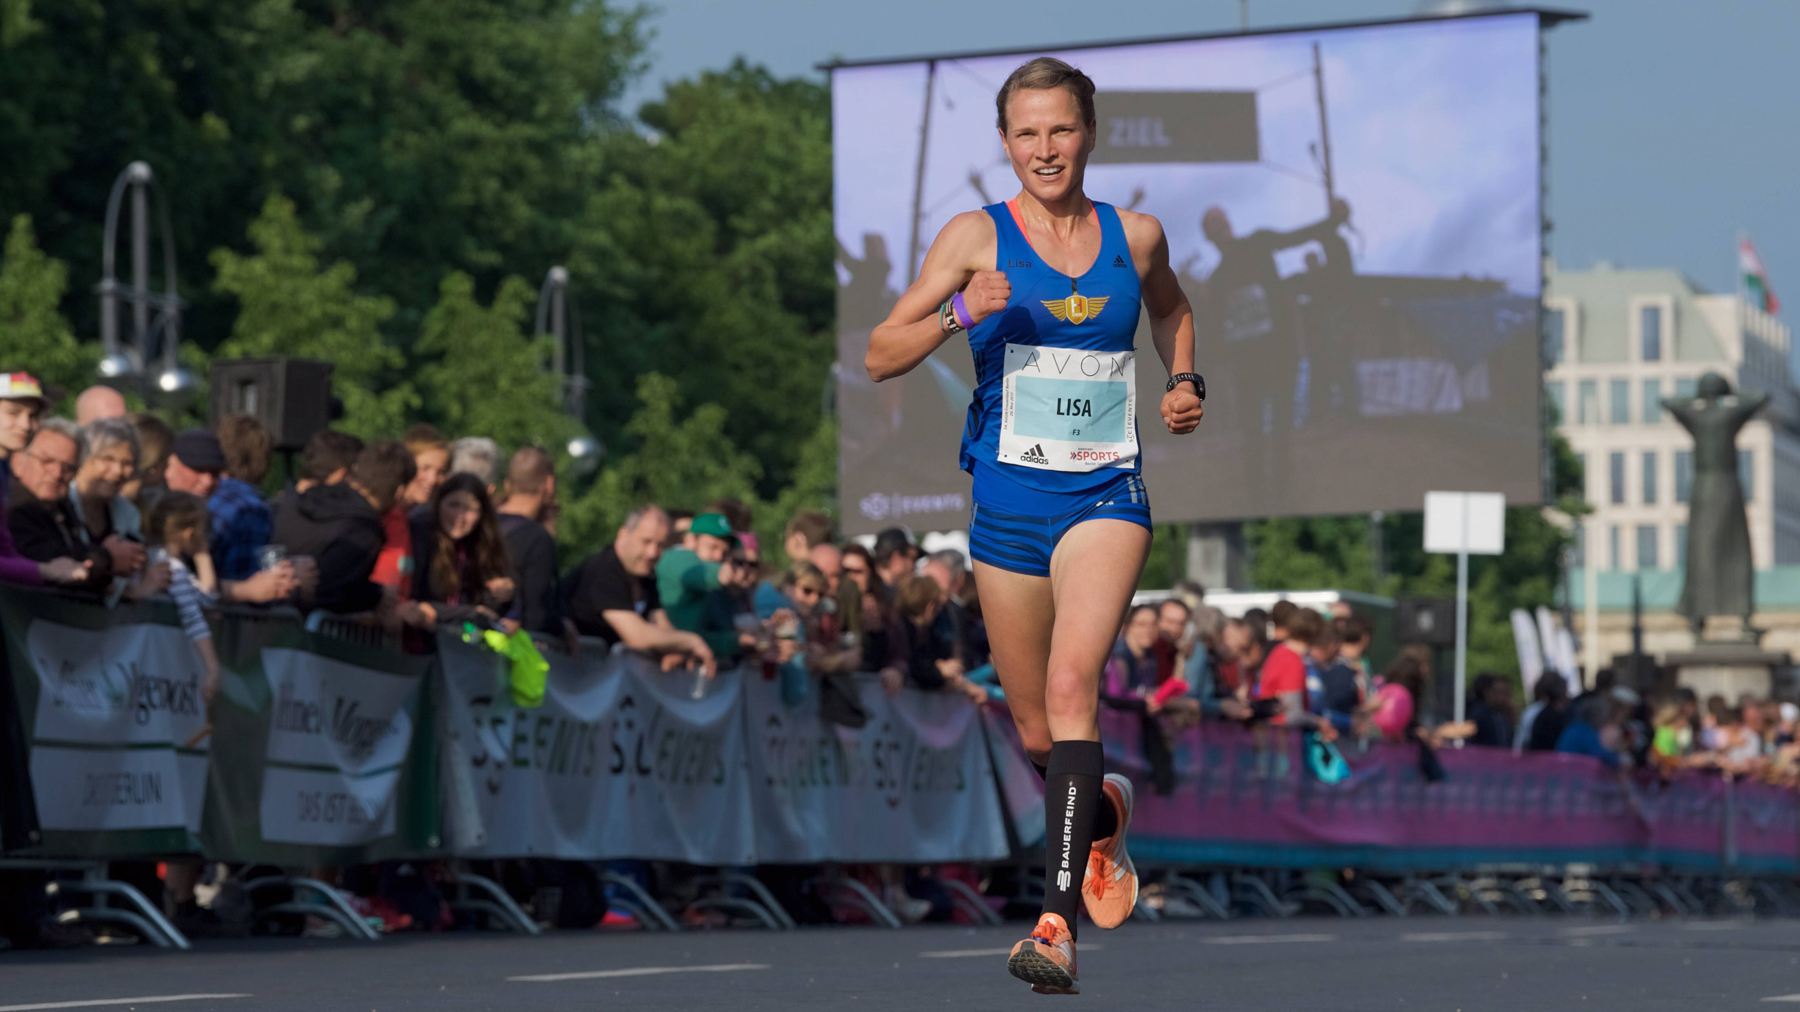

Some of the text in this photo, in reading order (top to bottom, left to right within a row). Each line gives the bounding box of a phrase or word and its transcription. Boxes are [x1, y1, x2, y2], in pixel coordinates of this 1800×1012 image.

[1108, 117, 1171, 146] ZIEL
[1008, 259, 1032, 268] Lisa
[1022, 352, 1125, 377] AVON
[1057, 398, 1092, 417] LISA
[1020, 455, 1049, 465] adidas
[1077, 451, 1120, 461] SPORTS
[1061, 785, 1077, 869] BAUERFEIND
